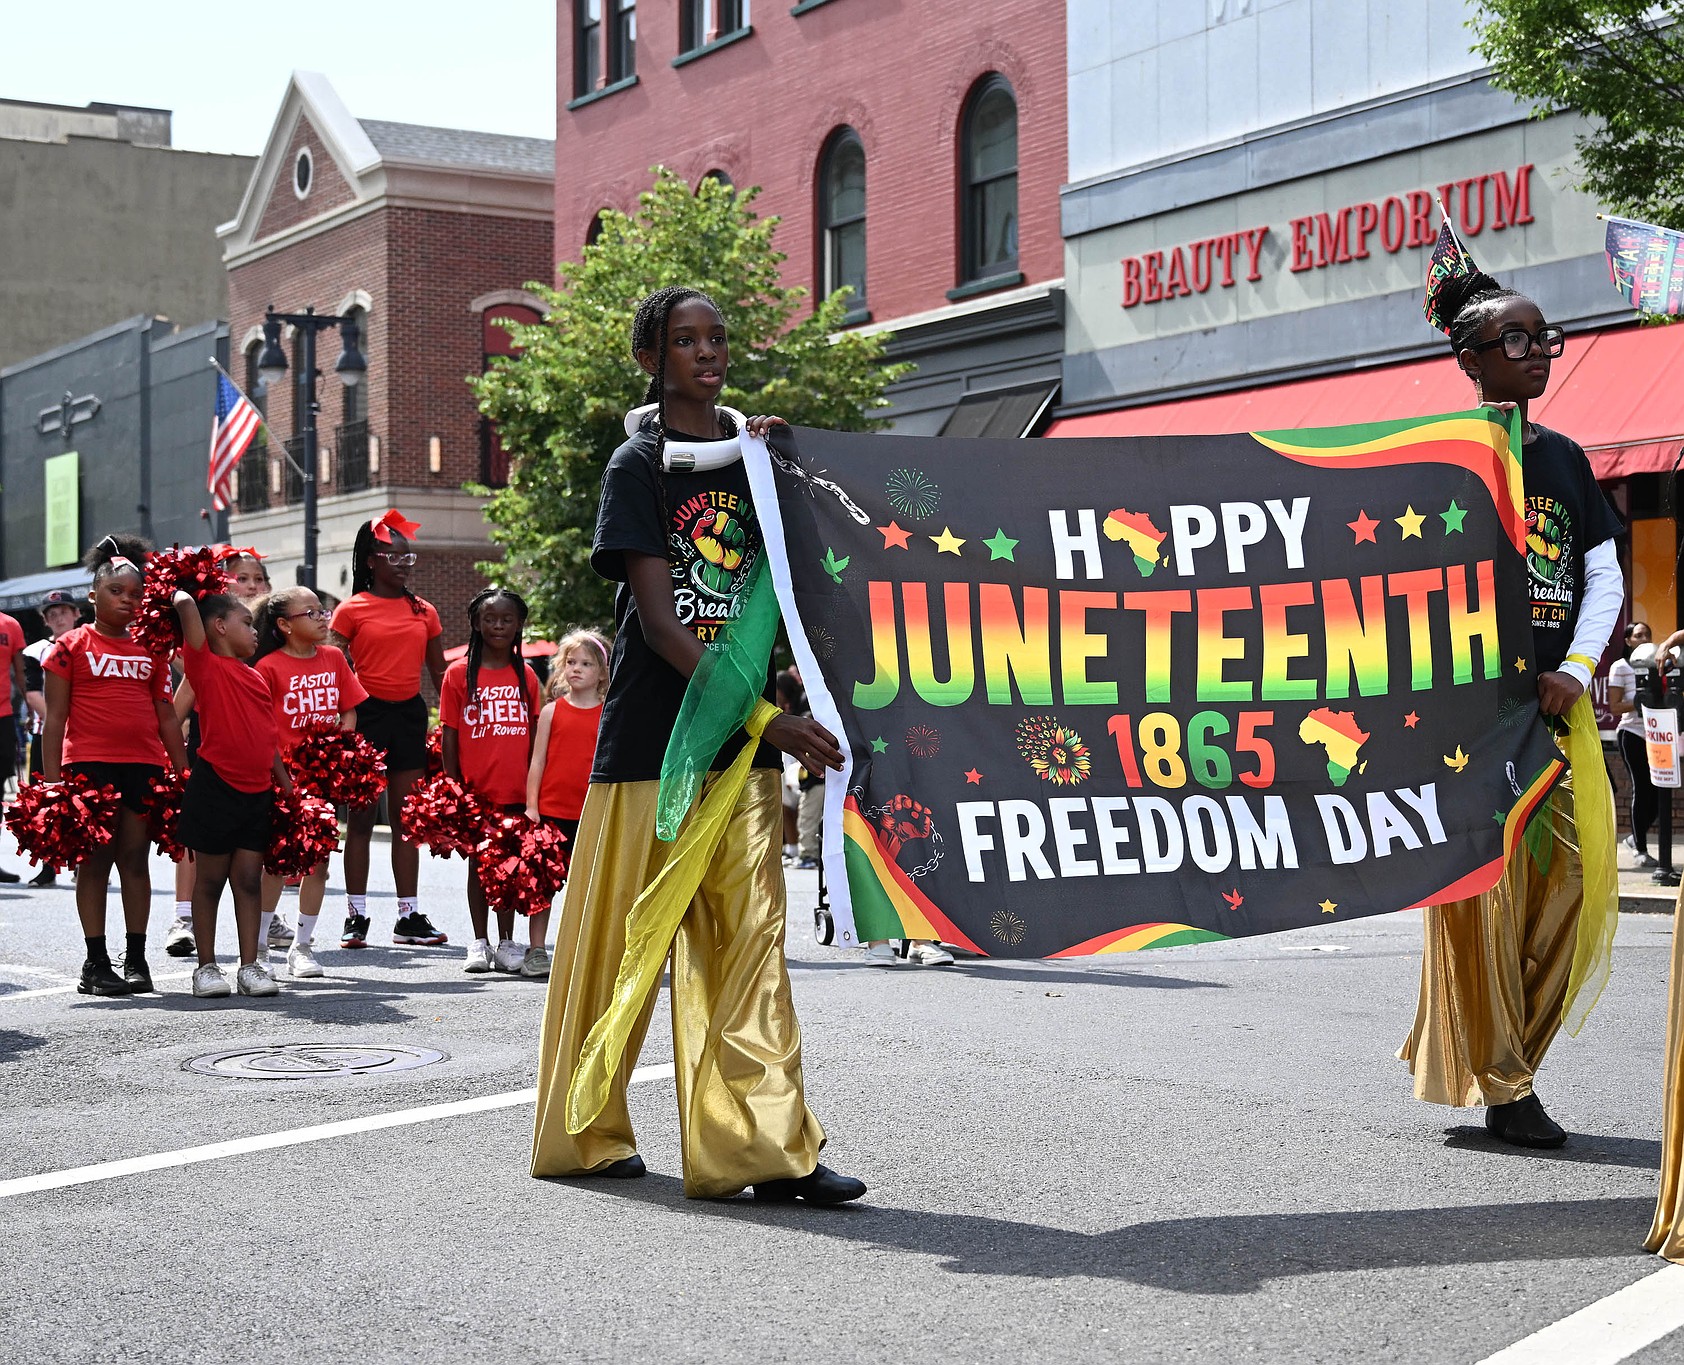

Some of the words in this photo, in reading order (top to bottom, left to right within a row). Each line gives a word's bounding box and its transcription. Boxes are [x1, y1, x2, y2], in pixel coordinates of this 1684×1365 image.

[1121, 226, 1269, 308] BEAUTY
[1289, 163, 1535, 273] EMPORIUM
[672, 491, 755, 530] JUNETEENT
[1524, 496, 1572, 529] ETEENTH
[1048, 496, 1311, 580] HPPY
[852, 560, 1504, 711] JUNETEENTH
[1531, 619, 1546, 628] SINCE
[85, 651, 152, 680] VANS
[471, 724, 490, 739] Lil'
[493, 724, 527, 736] Rovers
[1107, 710, 1276, 790] 1865
[1647, 731, 1673, 742] RKING
[956, 795, 1299, 882] FREEDOM
[1313, 783, 1448, 865] DAY
